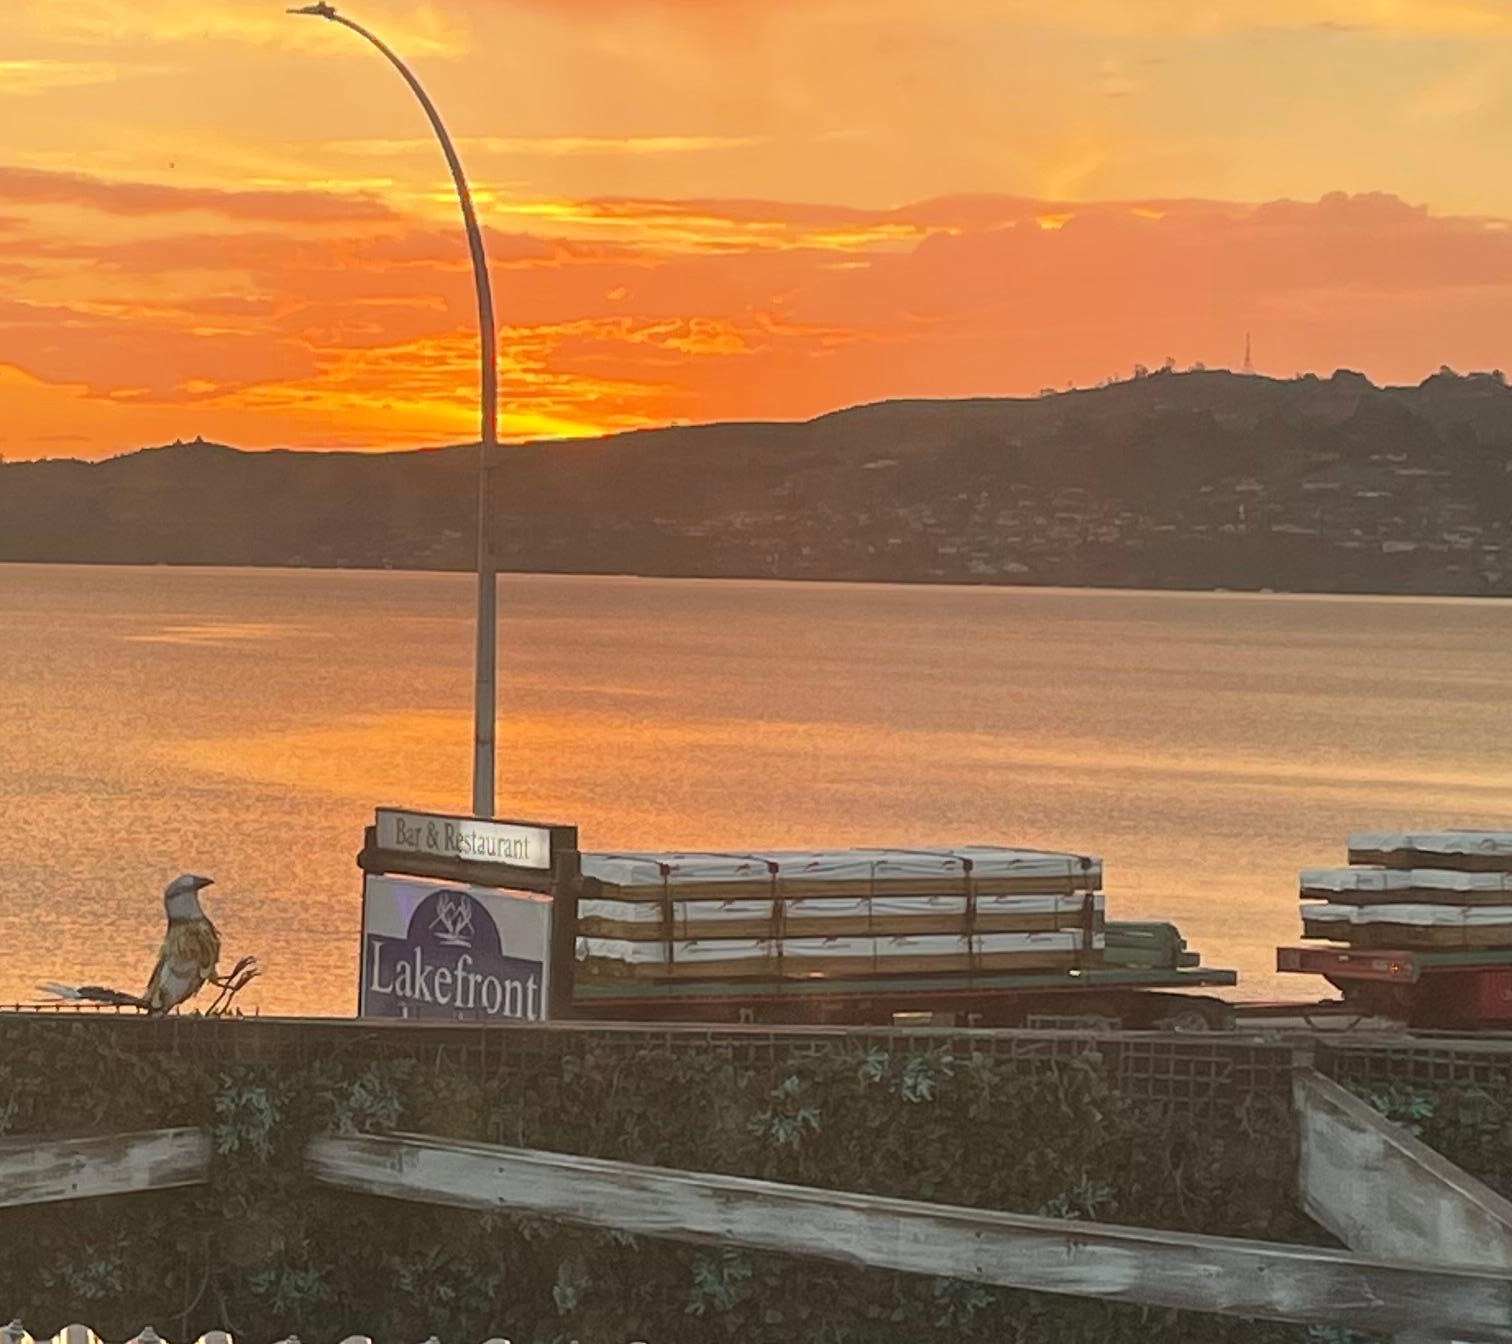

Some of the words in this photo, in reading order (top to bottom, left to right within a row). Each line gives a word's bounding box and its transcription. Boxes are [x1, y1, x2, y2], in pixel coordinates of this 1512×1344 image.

[395, 817, 421, 848] Bar
[426, 823, 439, 849] &
[444, 822, 530, 859] Restaurant
[370, 940, 538, 1022] Lakefront
